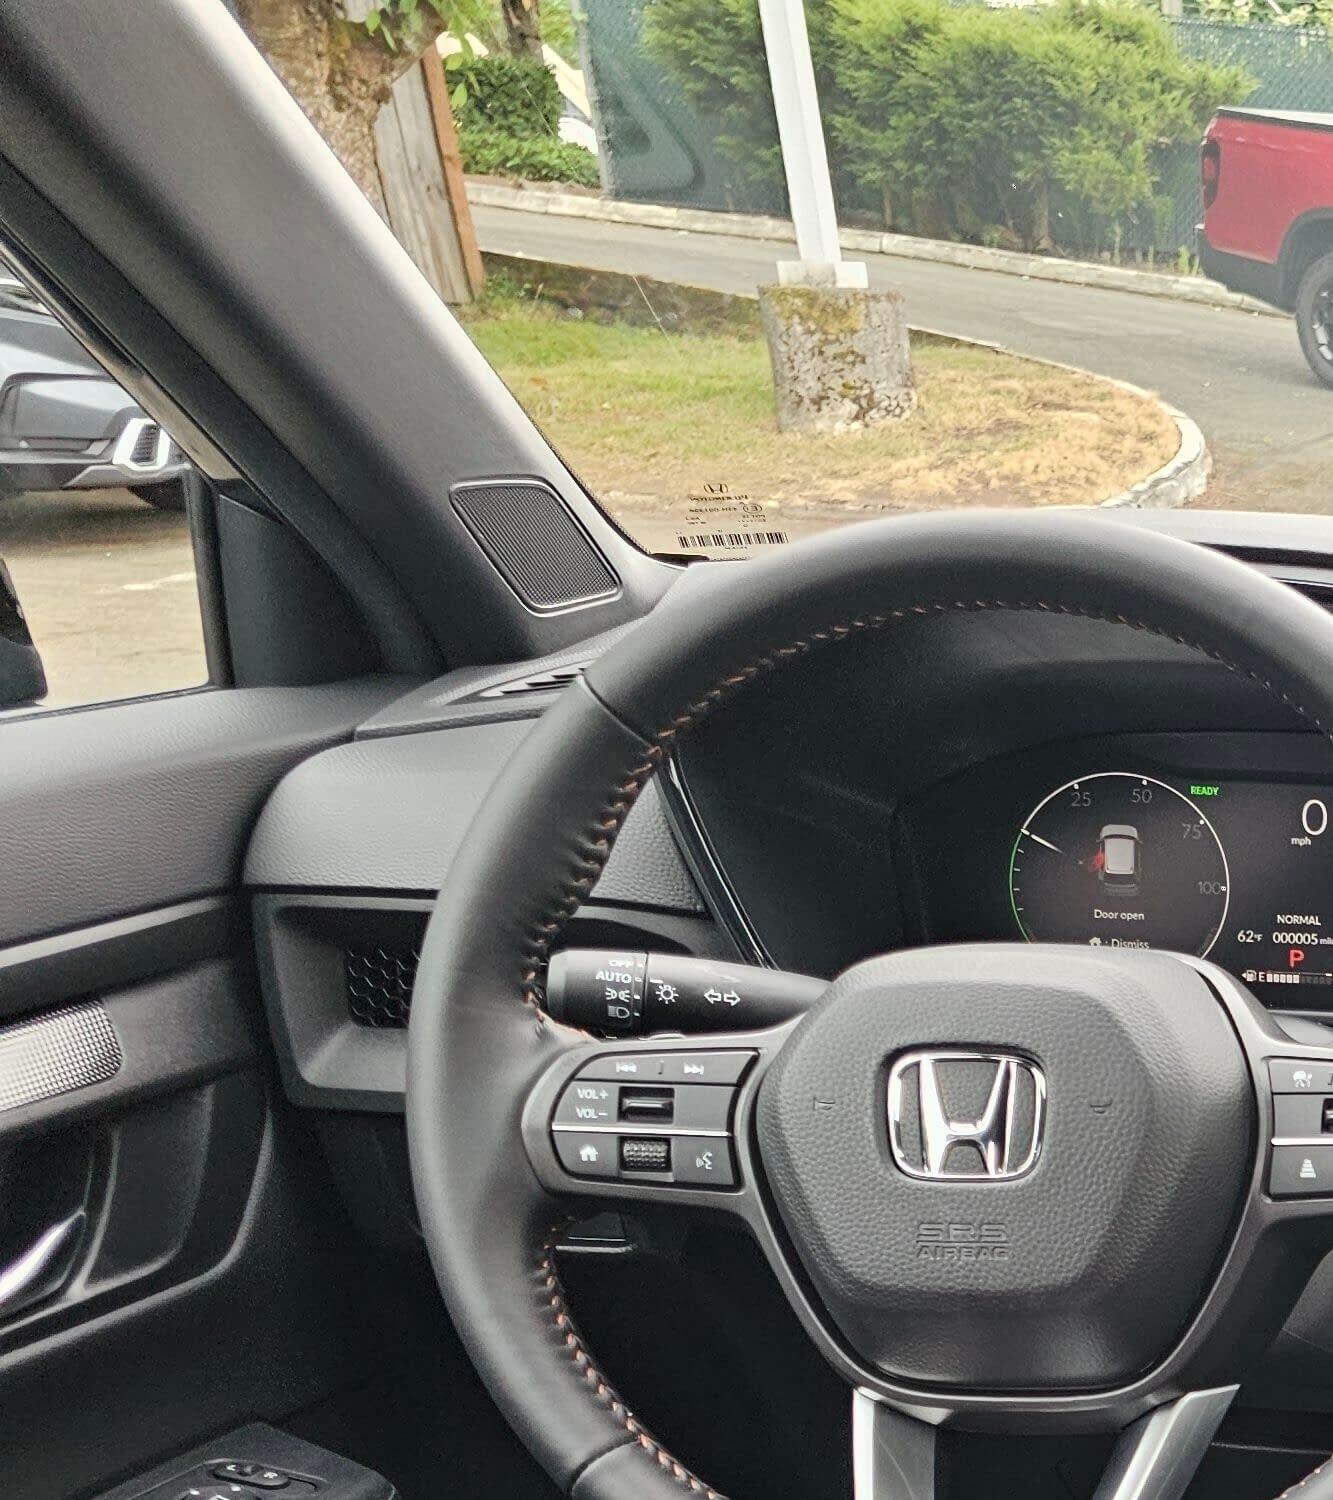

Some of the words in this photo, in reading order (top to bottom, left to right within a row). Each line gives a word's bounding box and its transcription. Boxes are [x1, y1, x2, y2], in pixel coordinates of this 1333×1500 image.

[1132, 789, 1152, 804] 50
[1190, 786, 1220, 796] READY
[1071, 791, 1092, 807] 25
[1302, 799, 1328, 836] 0
[1182, 824, 1201, 840] 75
[1291, 836, 1311, 846] mph
[1199, 881, 1221, 895] 100
[1094, 908, 1118, 920] Door
[1120, 912, 1145, 921] open
[1276, 914, 1321, 926] NORMAL
[1112, 938, 1150, 949] Dismiss
[1272, 932, 1318, 945] 000005
[1289, 949, 1304, 968] P
[595, 970, 631, 983] AUTO
[1258, 971, 1265, 982] E
[917, 1222, 1007, 1241] SRS
[917, 1245, 1010, 1261] AIRBAG
